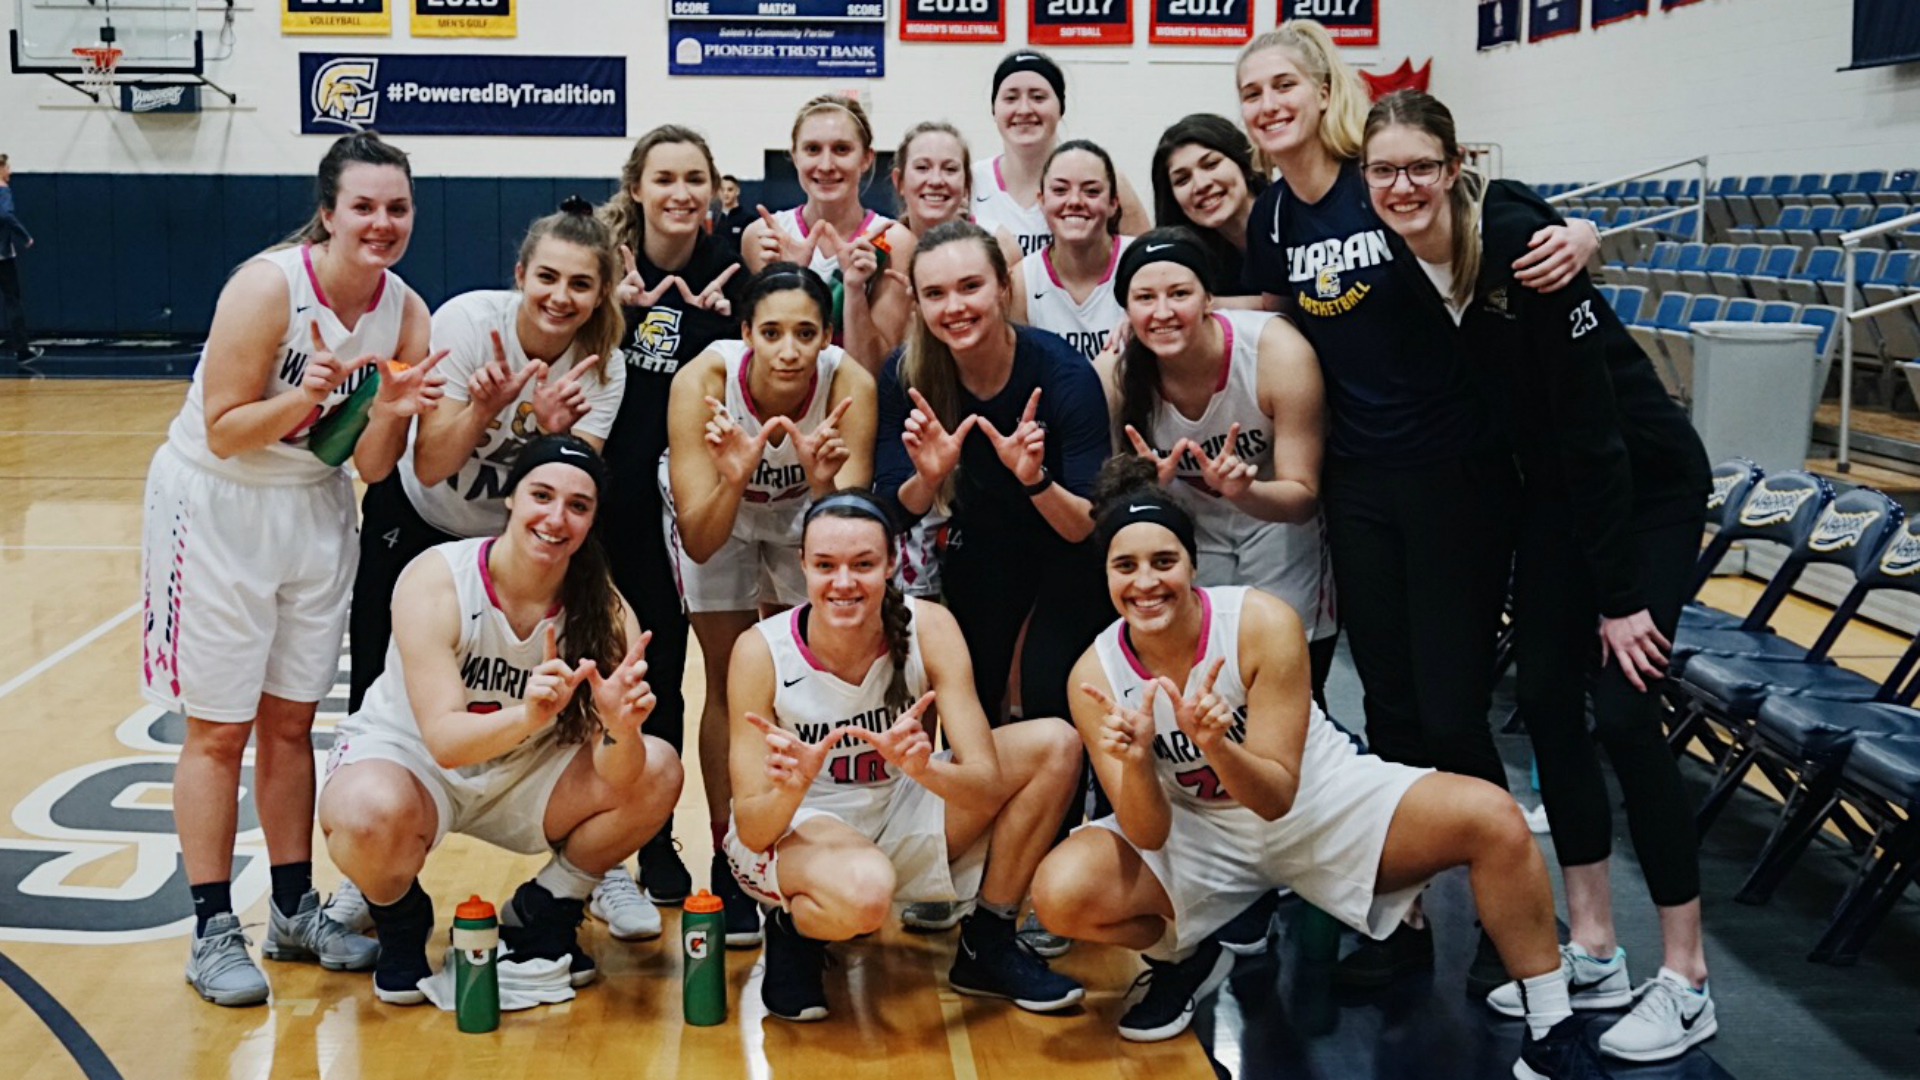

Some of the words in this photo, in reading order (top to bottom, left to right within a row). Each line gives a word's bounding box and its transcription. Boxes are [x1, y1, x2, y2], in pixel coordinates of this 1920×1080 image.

[675, 2, 709, 14] SCORE
[758, 3, 796, 14] MATCH
[847, 4, 881, 15] SCORE
[309, 16, 361, 26] VOLLEYBALL
[438, 19, 465, 28] MEN'S
[466, 19, 488, 28] GOLF
[906, 24, 947, 34] WOMEN'S
[949, 24, 998, 35] VOLLEYBALL
[1060, 27, 1101, 37] SOFTBALL
[1155, 27, 1196, 37] WOMEN'S
[1197, 27, 1247, 38] VOLLEYBALL
[704, 44, 775, 57] PIONEER
[777, 45, 828, 57] TRUST
[832, 46, 875, 58] BANK
[387, 82, 615, 108] #PoweredByTradition
[1569, 299, 1598, 339] 23
[382, 527, 400, 548] 4
